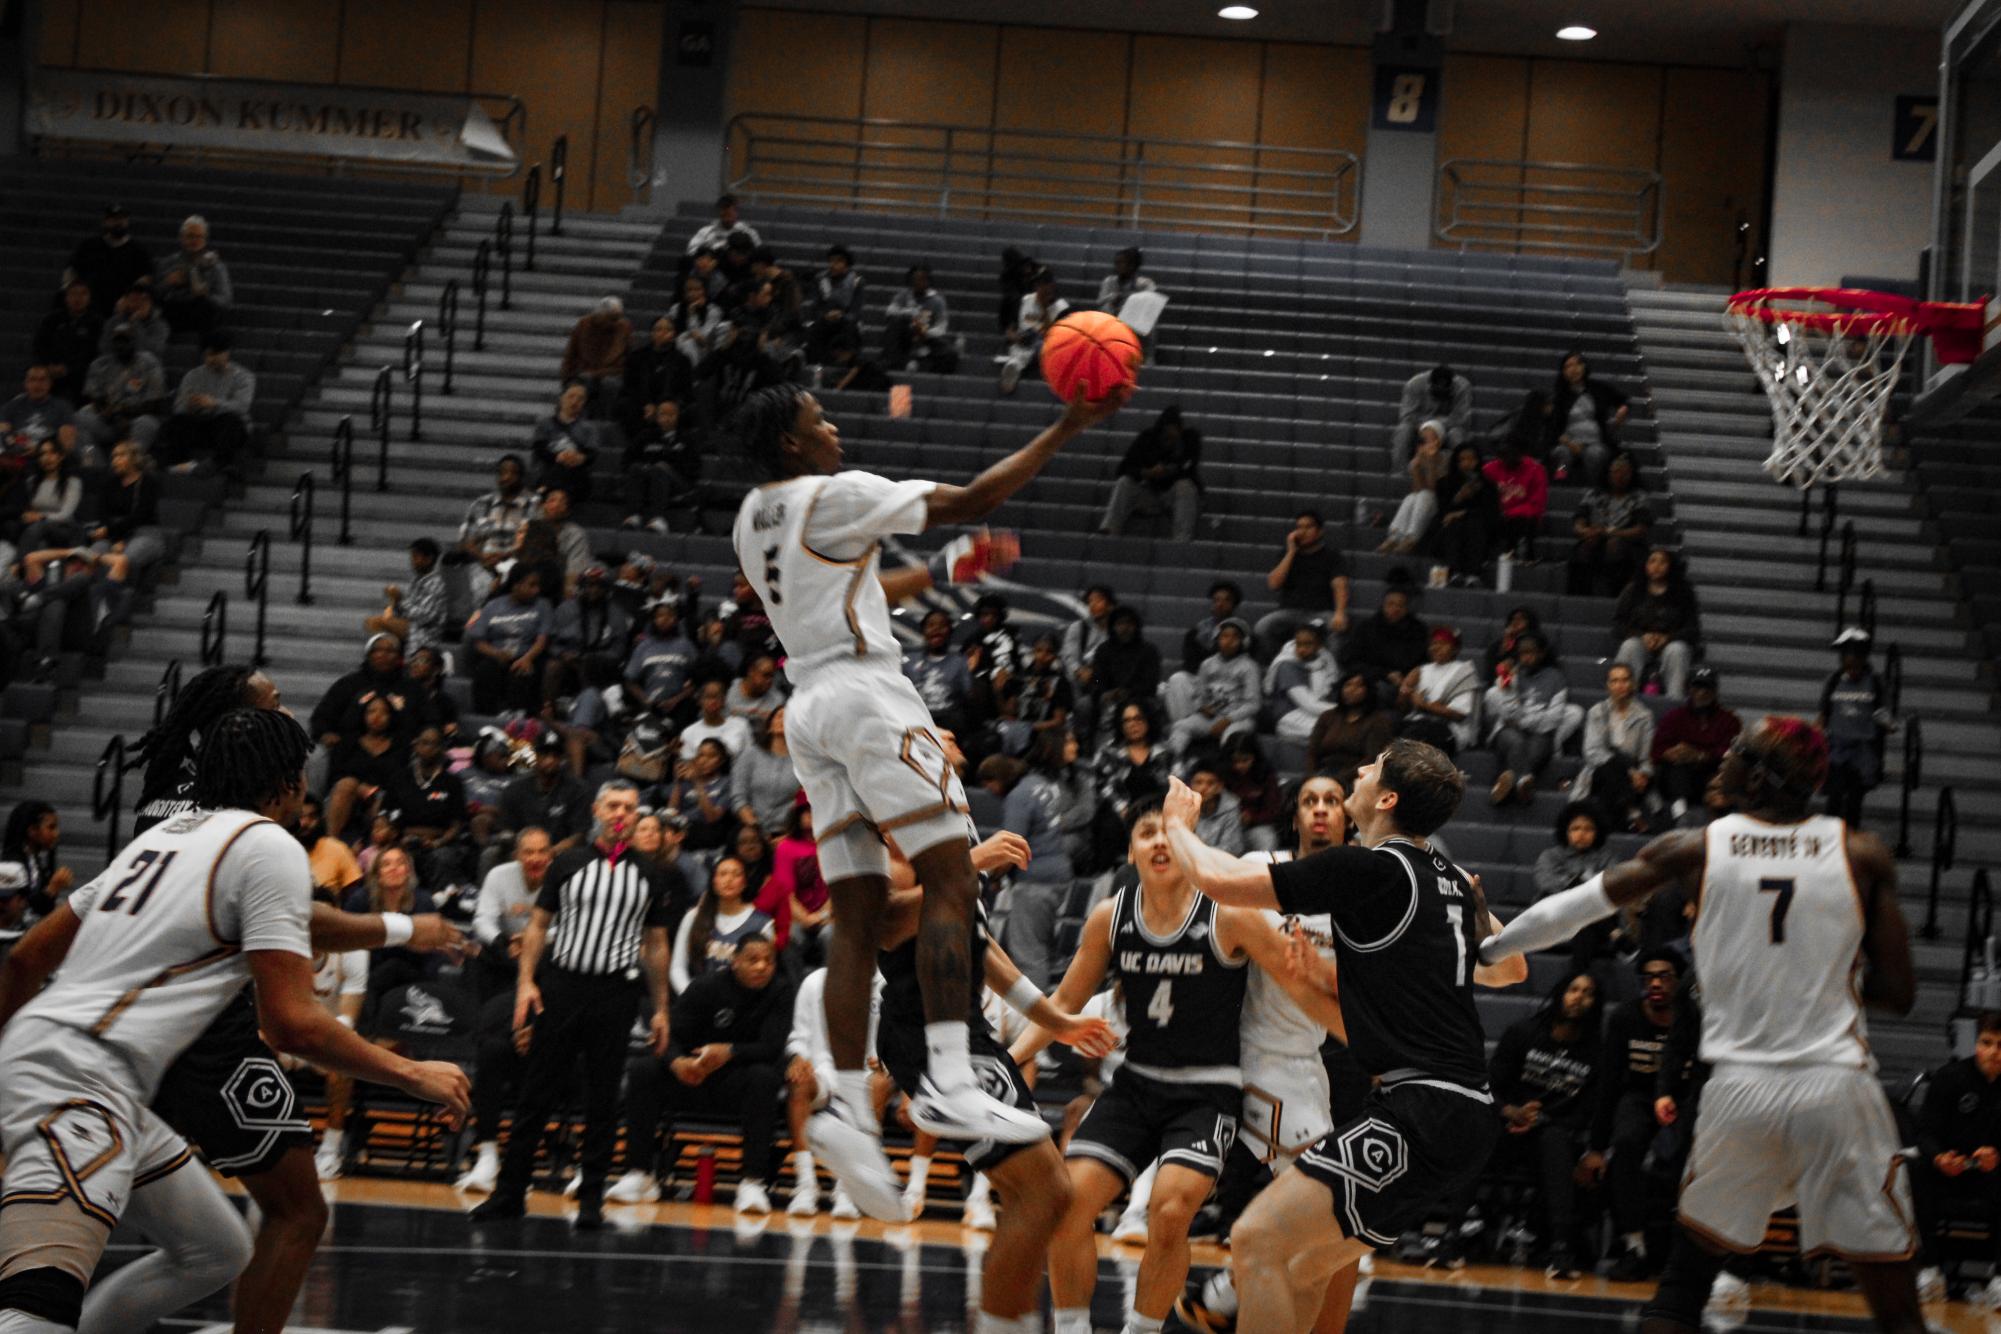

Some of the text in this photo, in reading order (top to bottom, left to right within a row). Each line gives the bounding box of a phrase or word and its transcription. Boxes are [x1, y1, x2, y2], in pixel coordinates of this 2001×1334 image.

[93, 90, 422, 142] DIXON KUMMER
[1386, 74, 1425, 123] 8
[1904, 103, 1938, 154] 7
[100, 850, 174, 915] 21
[1759, 877, 1796, 945] 7
[1121, 950, 1203, 976] UC DAVIS
[1446, 904, 1467, 987] 1
[1147, 979, 1175, 1029] 4
